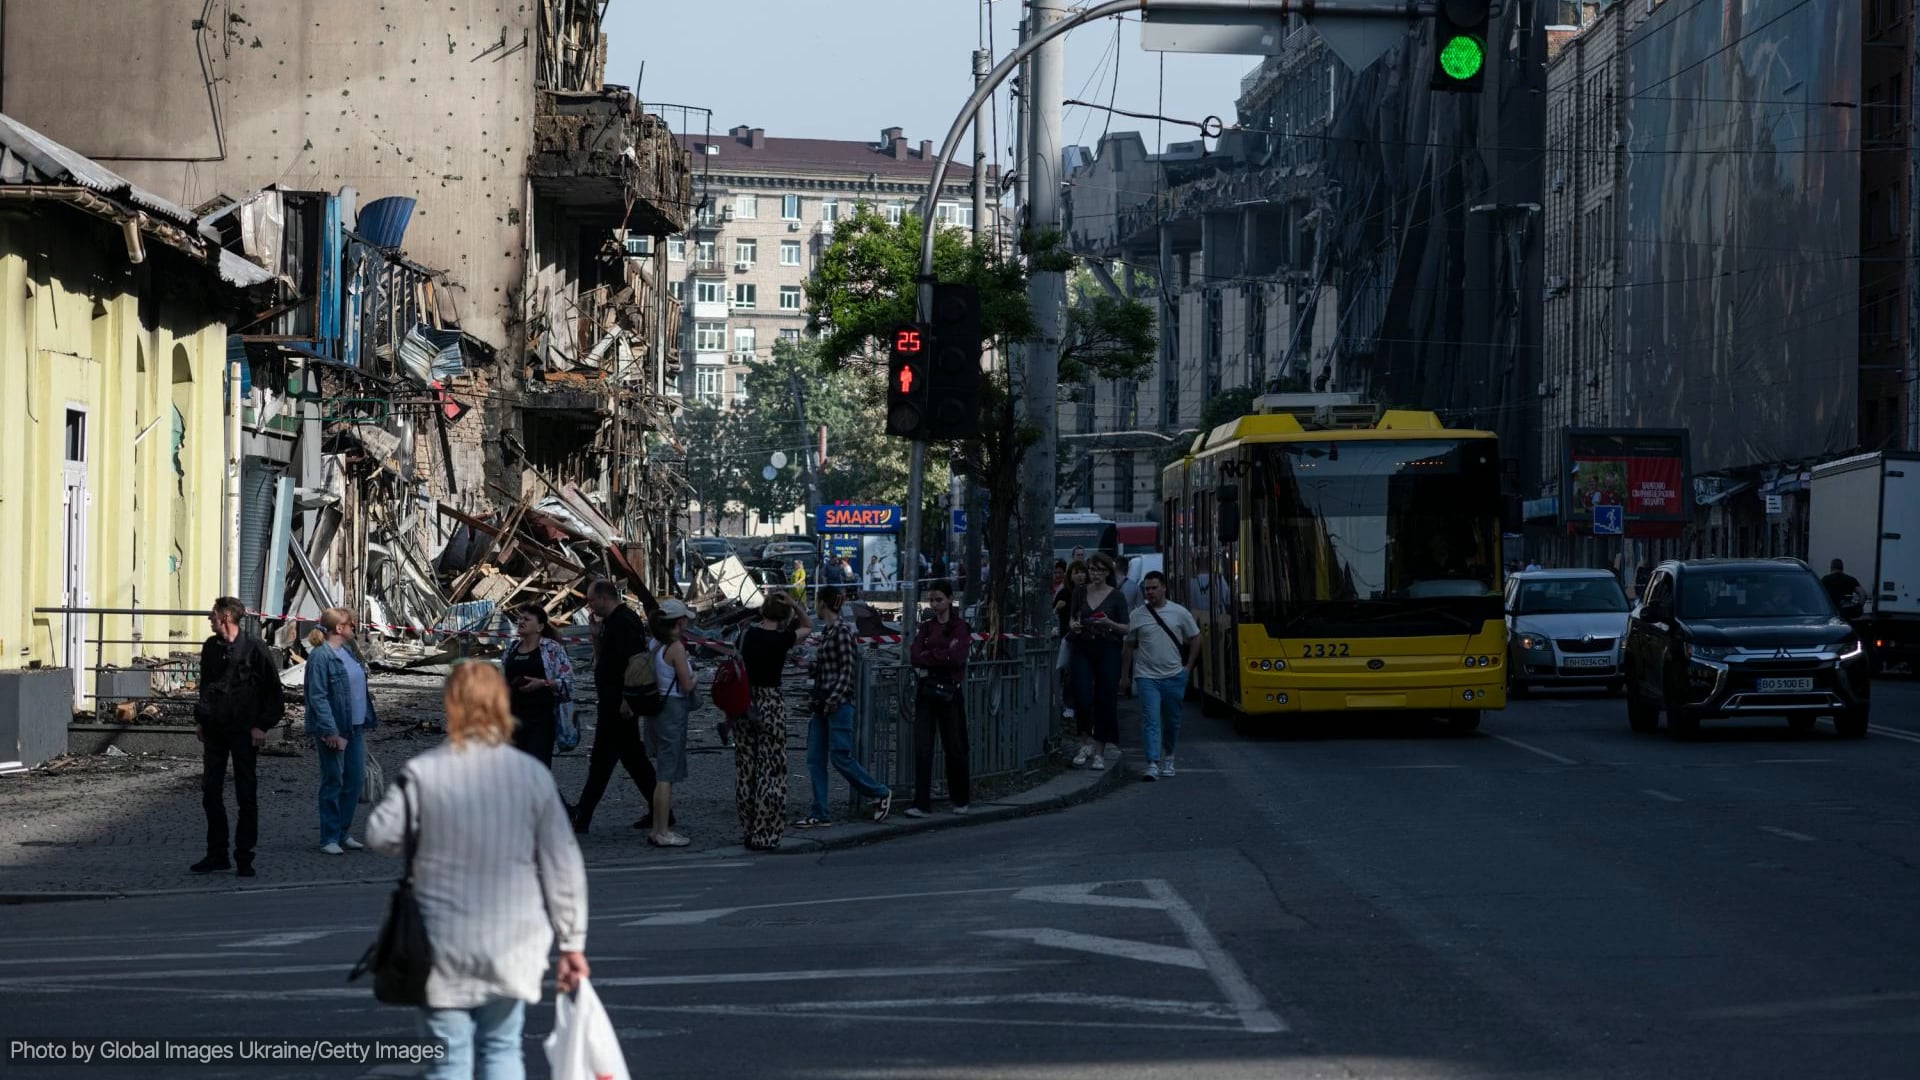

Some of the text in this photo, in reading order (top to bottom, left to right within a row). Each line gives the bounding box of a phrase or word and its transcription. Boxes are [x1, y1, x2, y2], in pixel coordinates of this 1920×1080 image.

[897, 331, 921, 352] 25
[825, 508, 880, 524] SMART
[1303, 643, 1350, 658] 2322
[1762, 679, 1775, 689] BO
[1777, 679, 1797, 689] 5100
